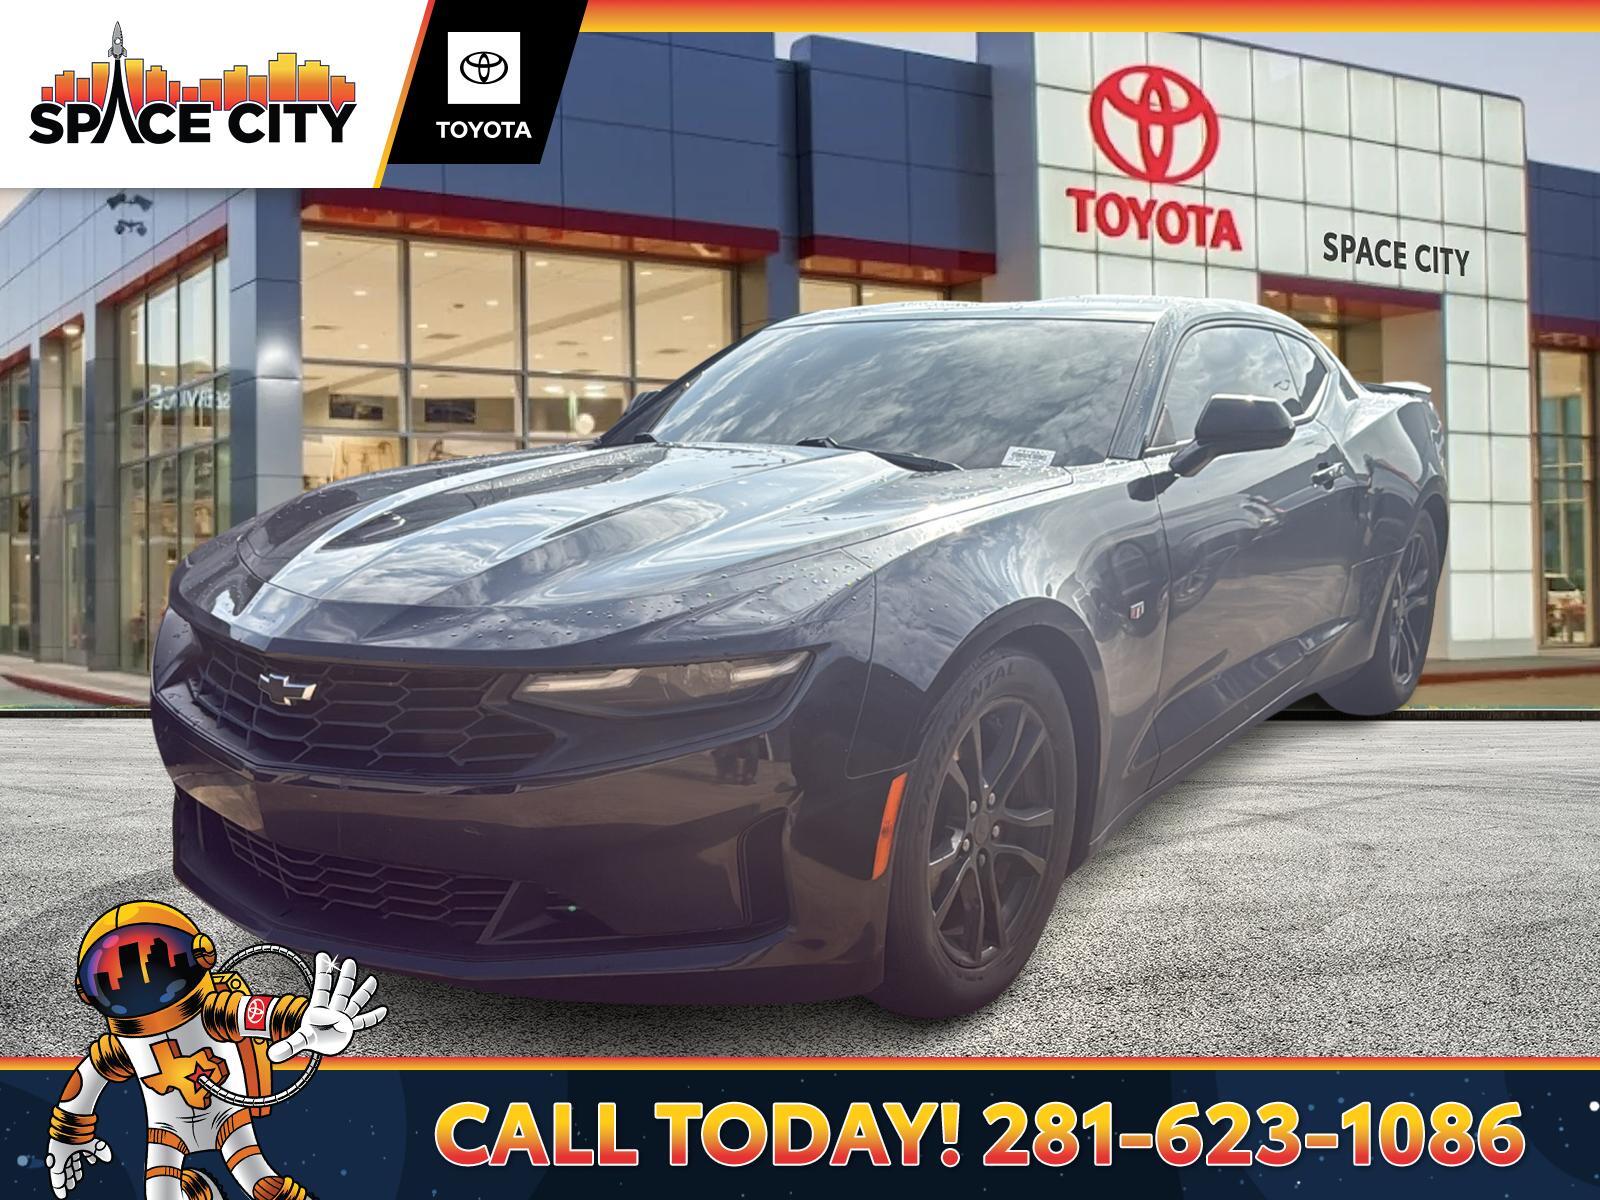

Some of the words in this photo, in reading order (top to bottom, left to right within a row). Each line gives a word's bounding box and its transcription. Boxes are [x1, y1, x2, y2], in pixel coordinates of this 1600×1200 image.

[1066, 187, 1243, 251] TOYOTA
[1322, 231, 1407, 270] SPACE
[1414, 243, 1470, 277] CITY
